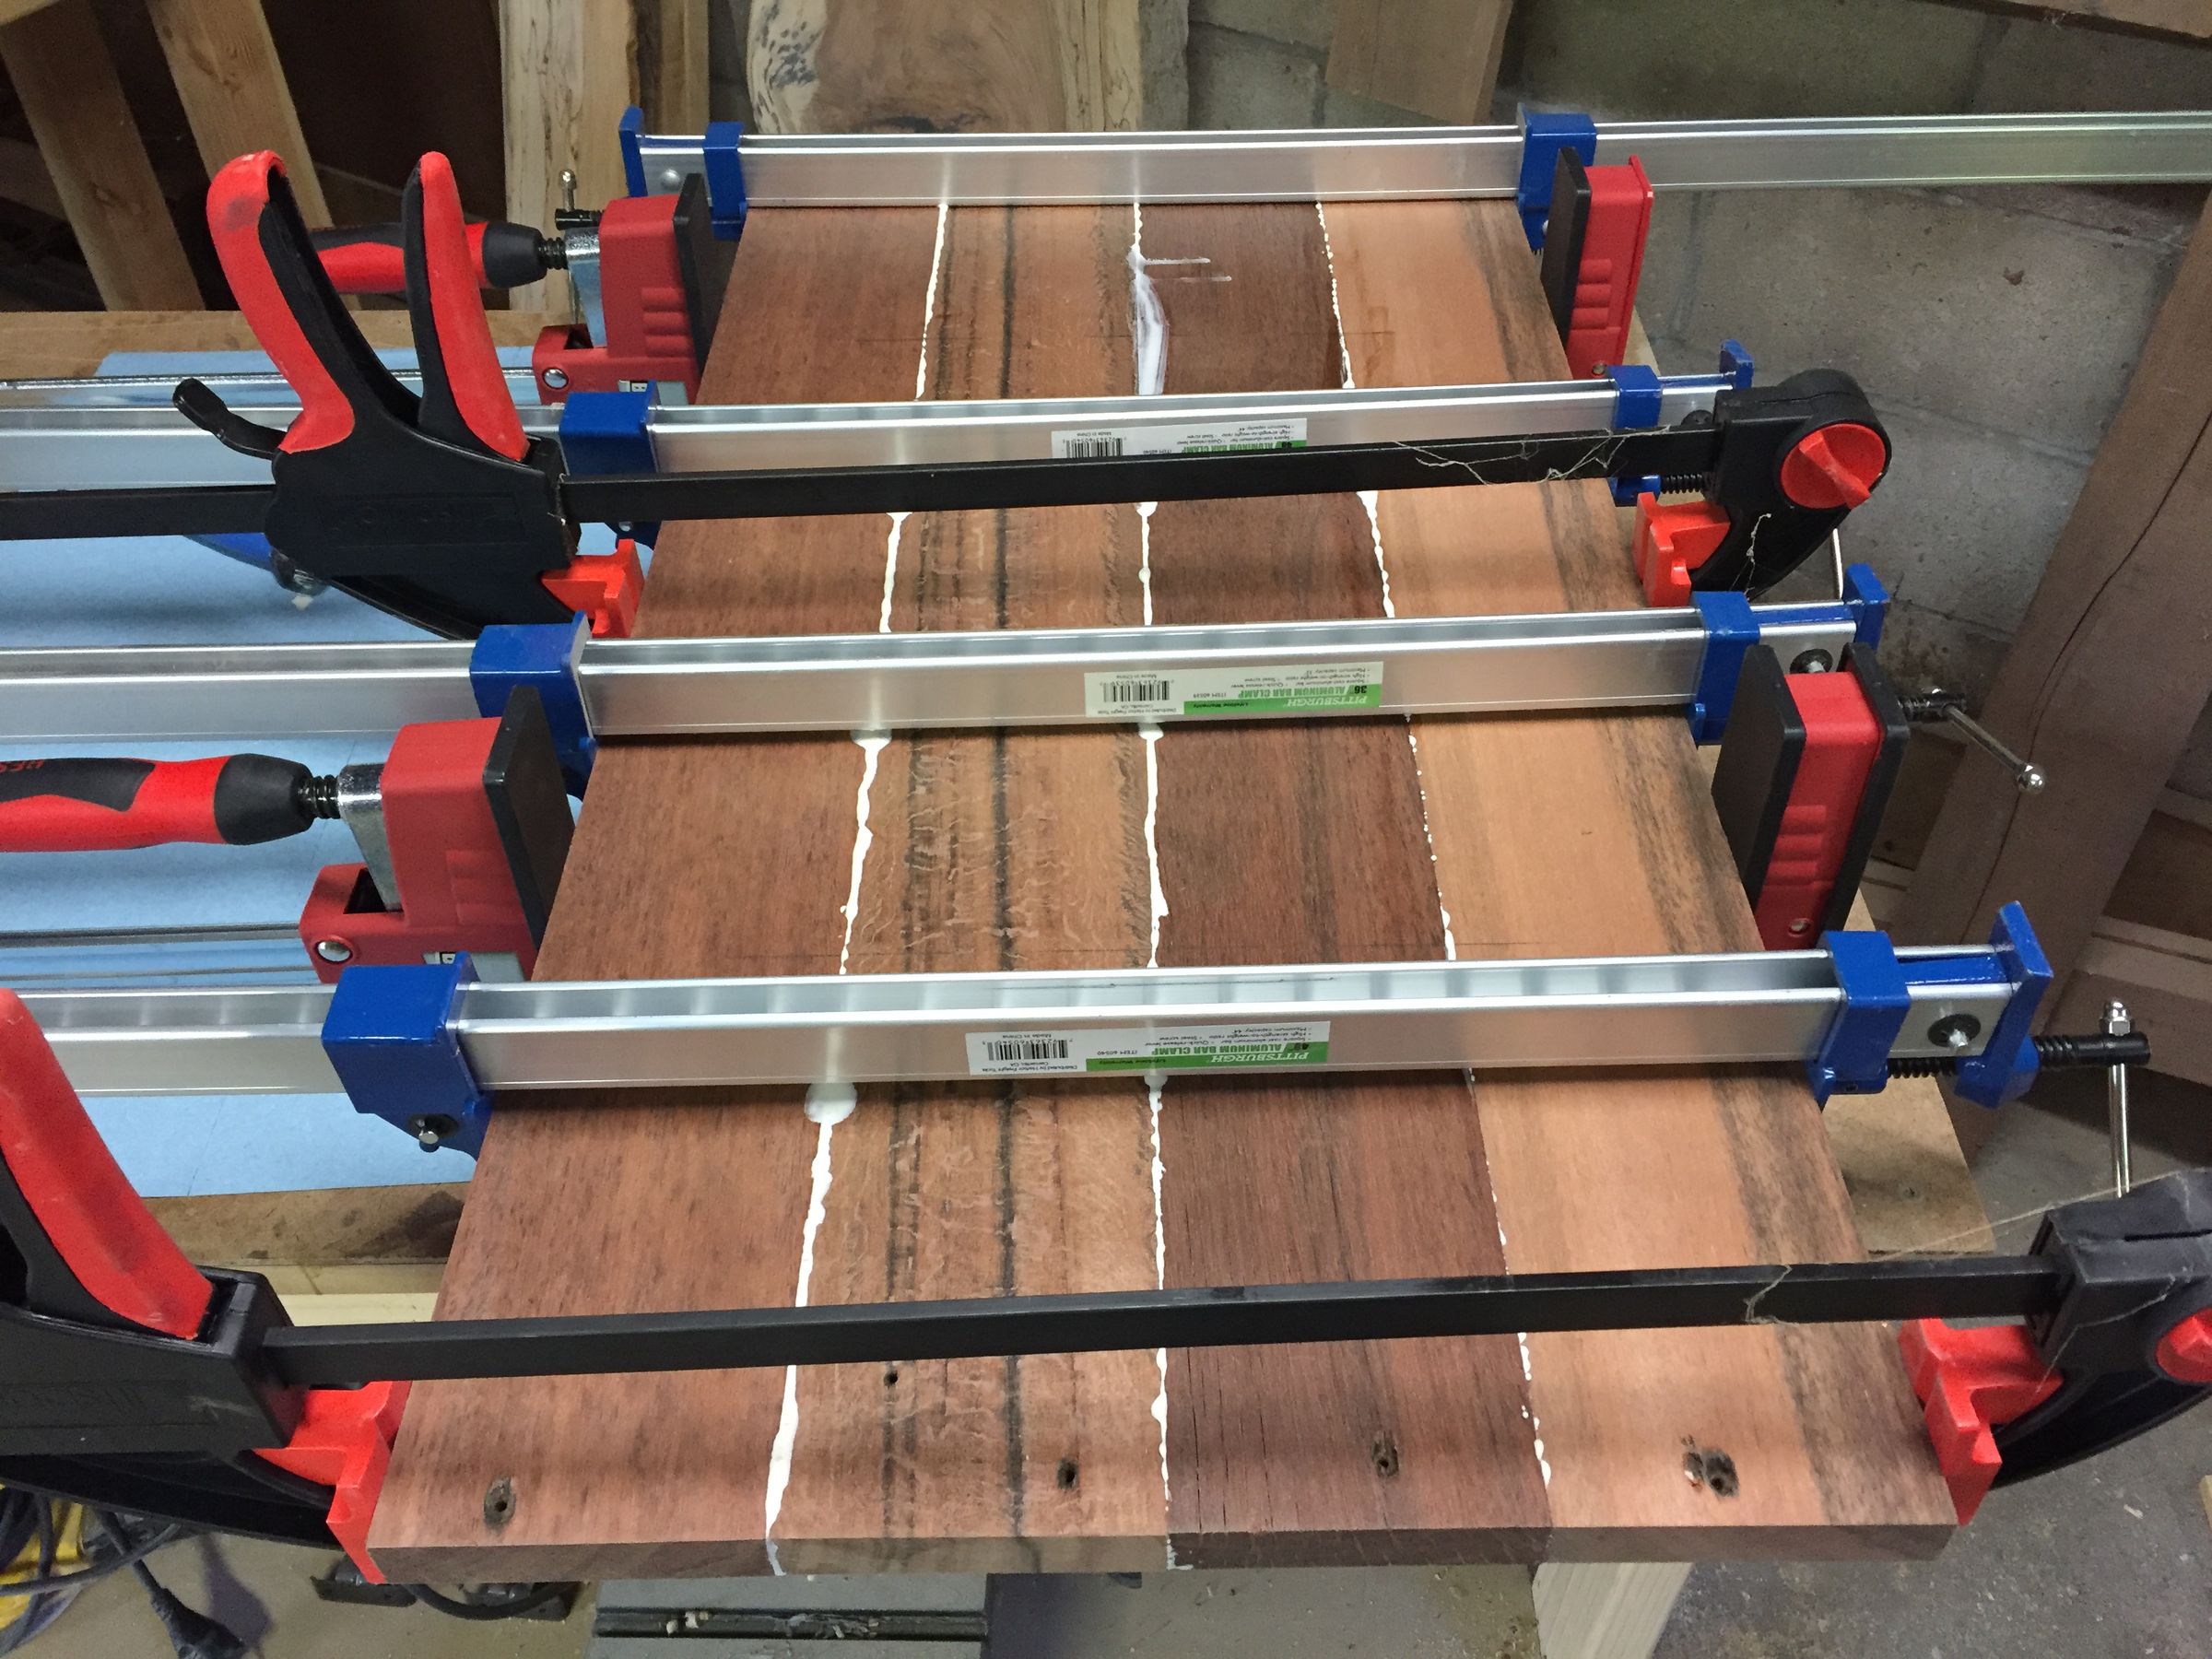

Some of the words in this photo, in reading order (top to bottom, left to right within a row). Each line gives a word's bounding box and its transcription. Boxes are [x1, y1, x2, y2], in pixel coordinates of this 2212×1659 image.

[1238, 689, 1270, 699] CLAMP
[1273, 688, 1291, 697] BAR
[1294, 687, 1345, 696] ALUMINUM
[1287, 695, 1367, 707] PITTSBURGH
[1151, 1047, 1190, 1056] CLAMP
[1194, 1046, 1217, 1054] BAR
[1219, 1044, 1282, 1053] ALUMINUM
[1211, 1053, 1309, 1063] PITTSBURGH
